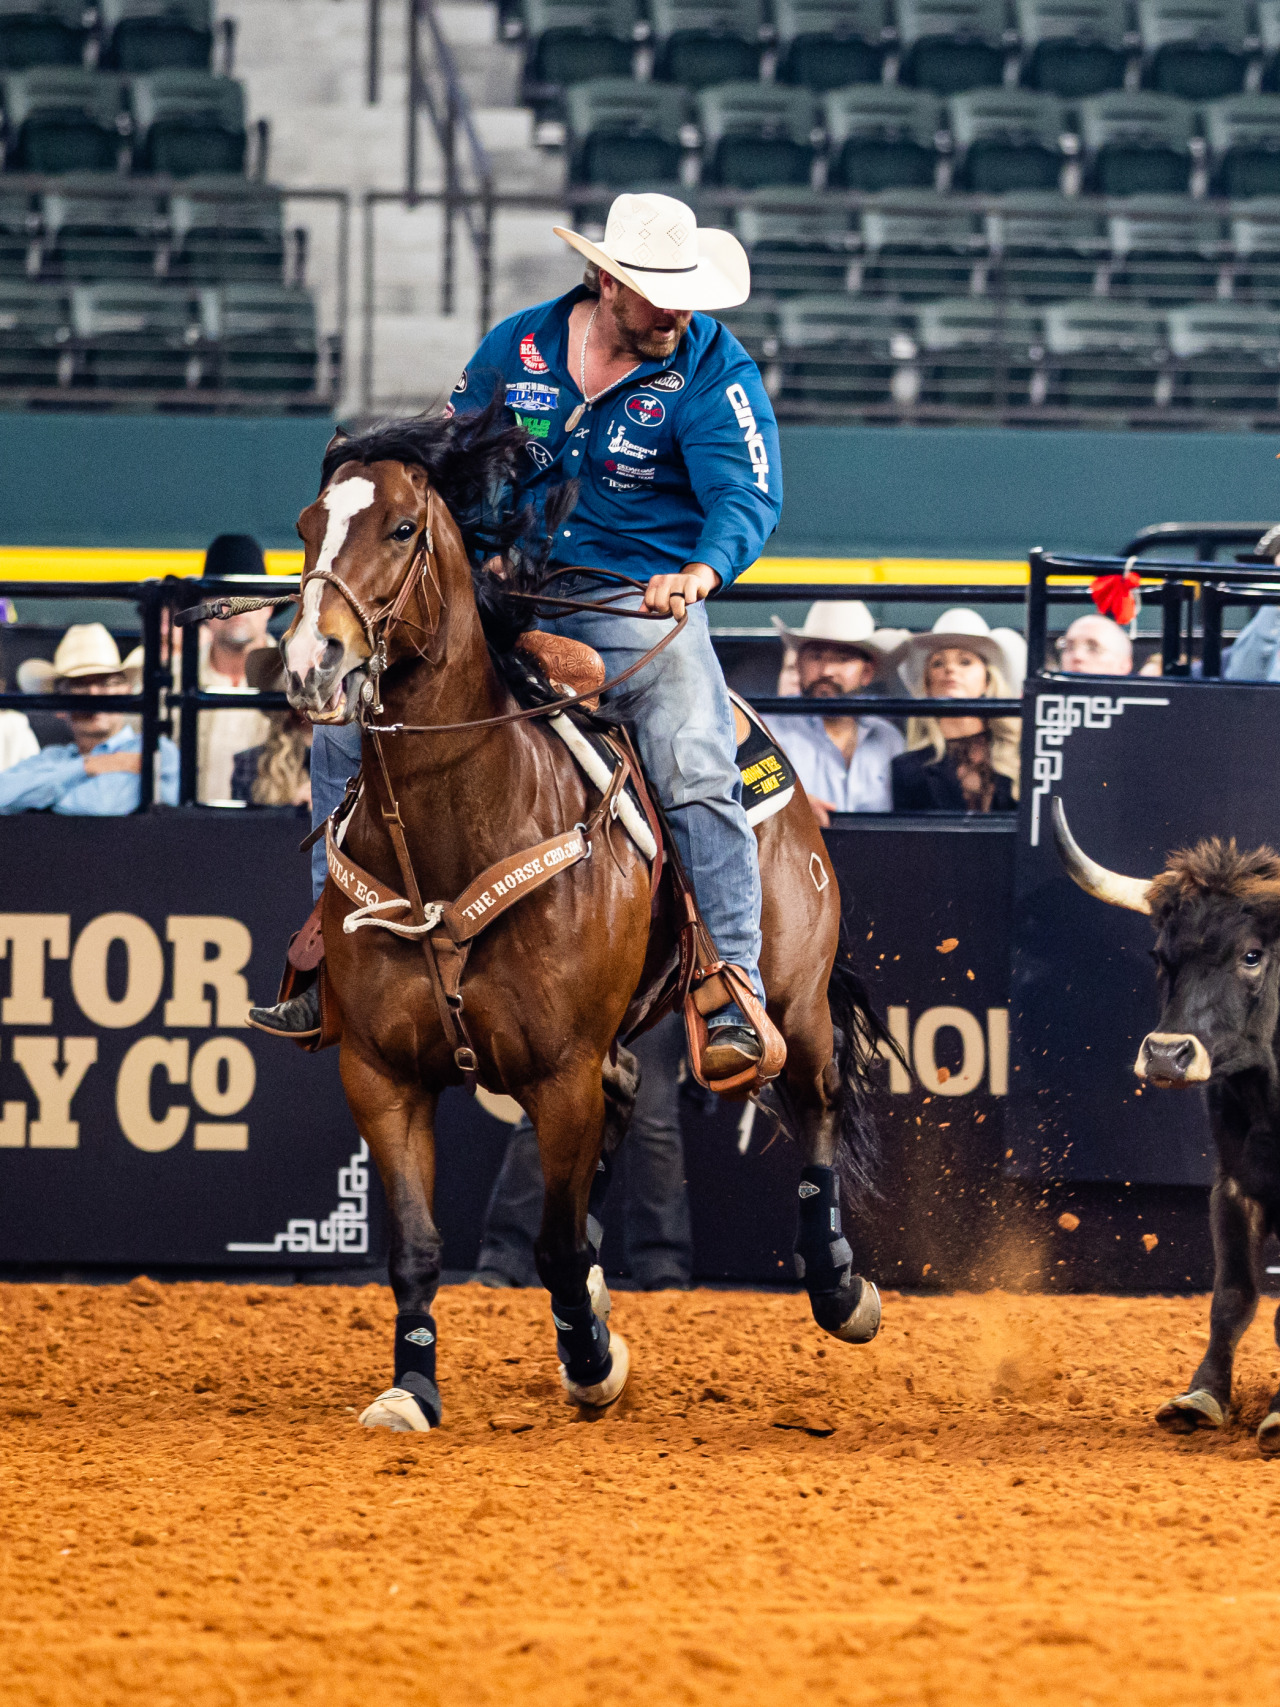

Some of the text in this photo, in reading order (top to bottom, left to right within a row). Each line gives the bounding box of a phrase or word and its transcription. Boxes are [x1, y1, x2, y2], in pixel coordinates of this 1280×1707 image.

[653, 376, 681, 390] ustin
[619, 446, 644, 460] Rack
[622, 439, 658, 456] Record
[725, 383, 769, 493] CINCH
[461, 890, 497, 921] THE
[491, 858, 545, 897] HORSE
[0, 911, 255, 1029] TOR
